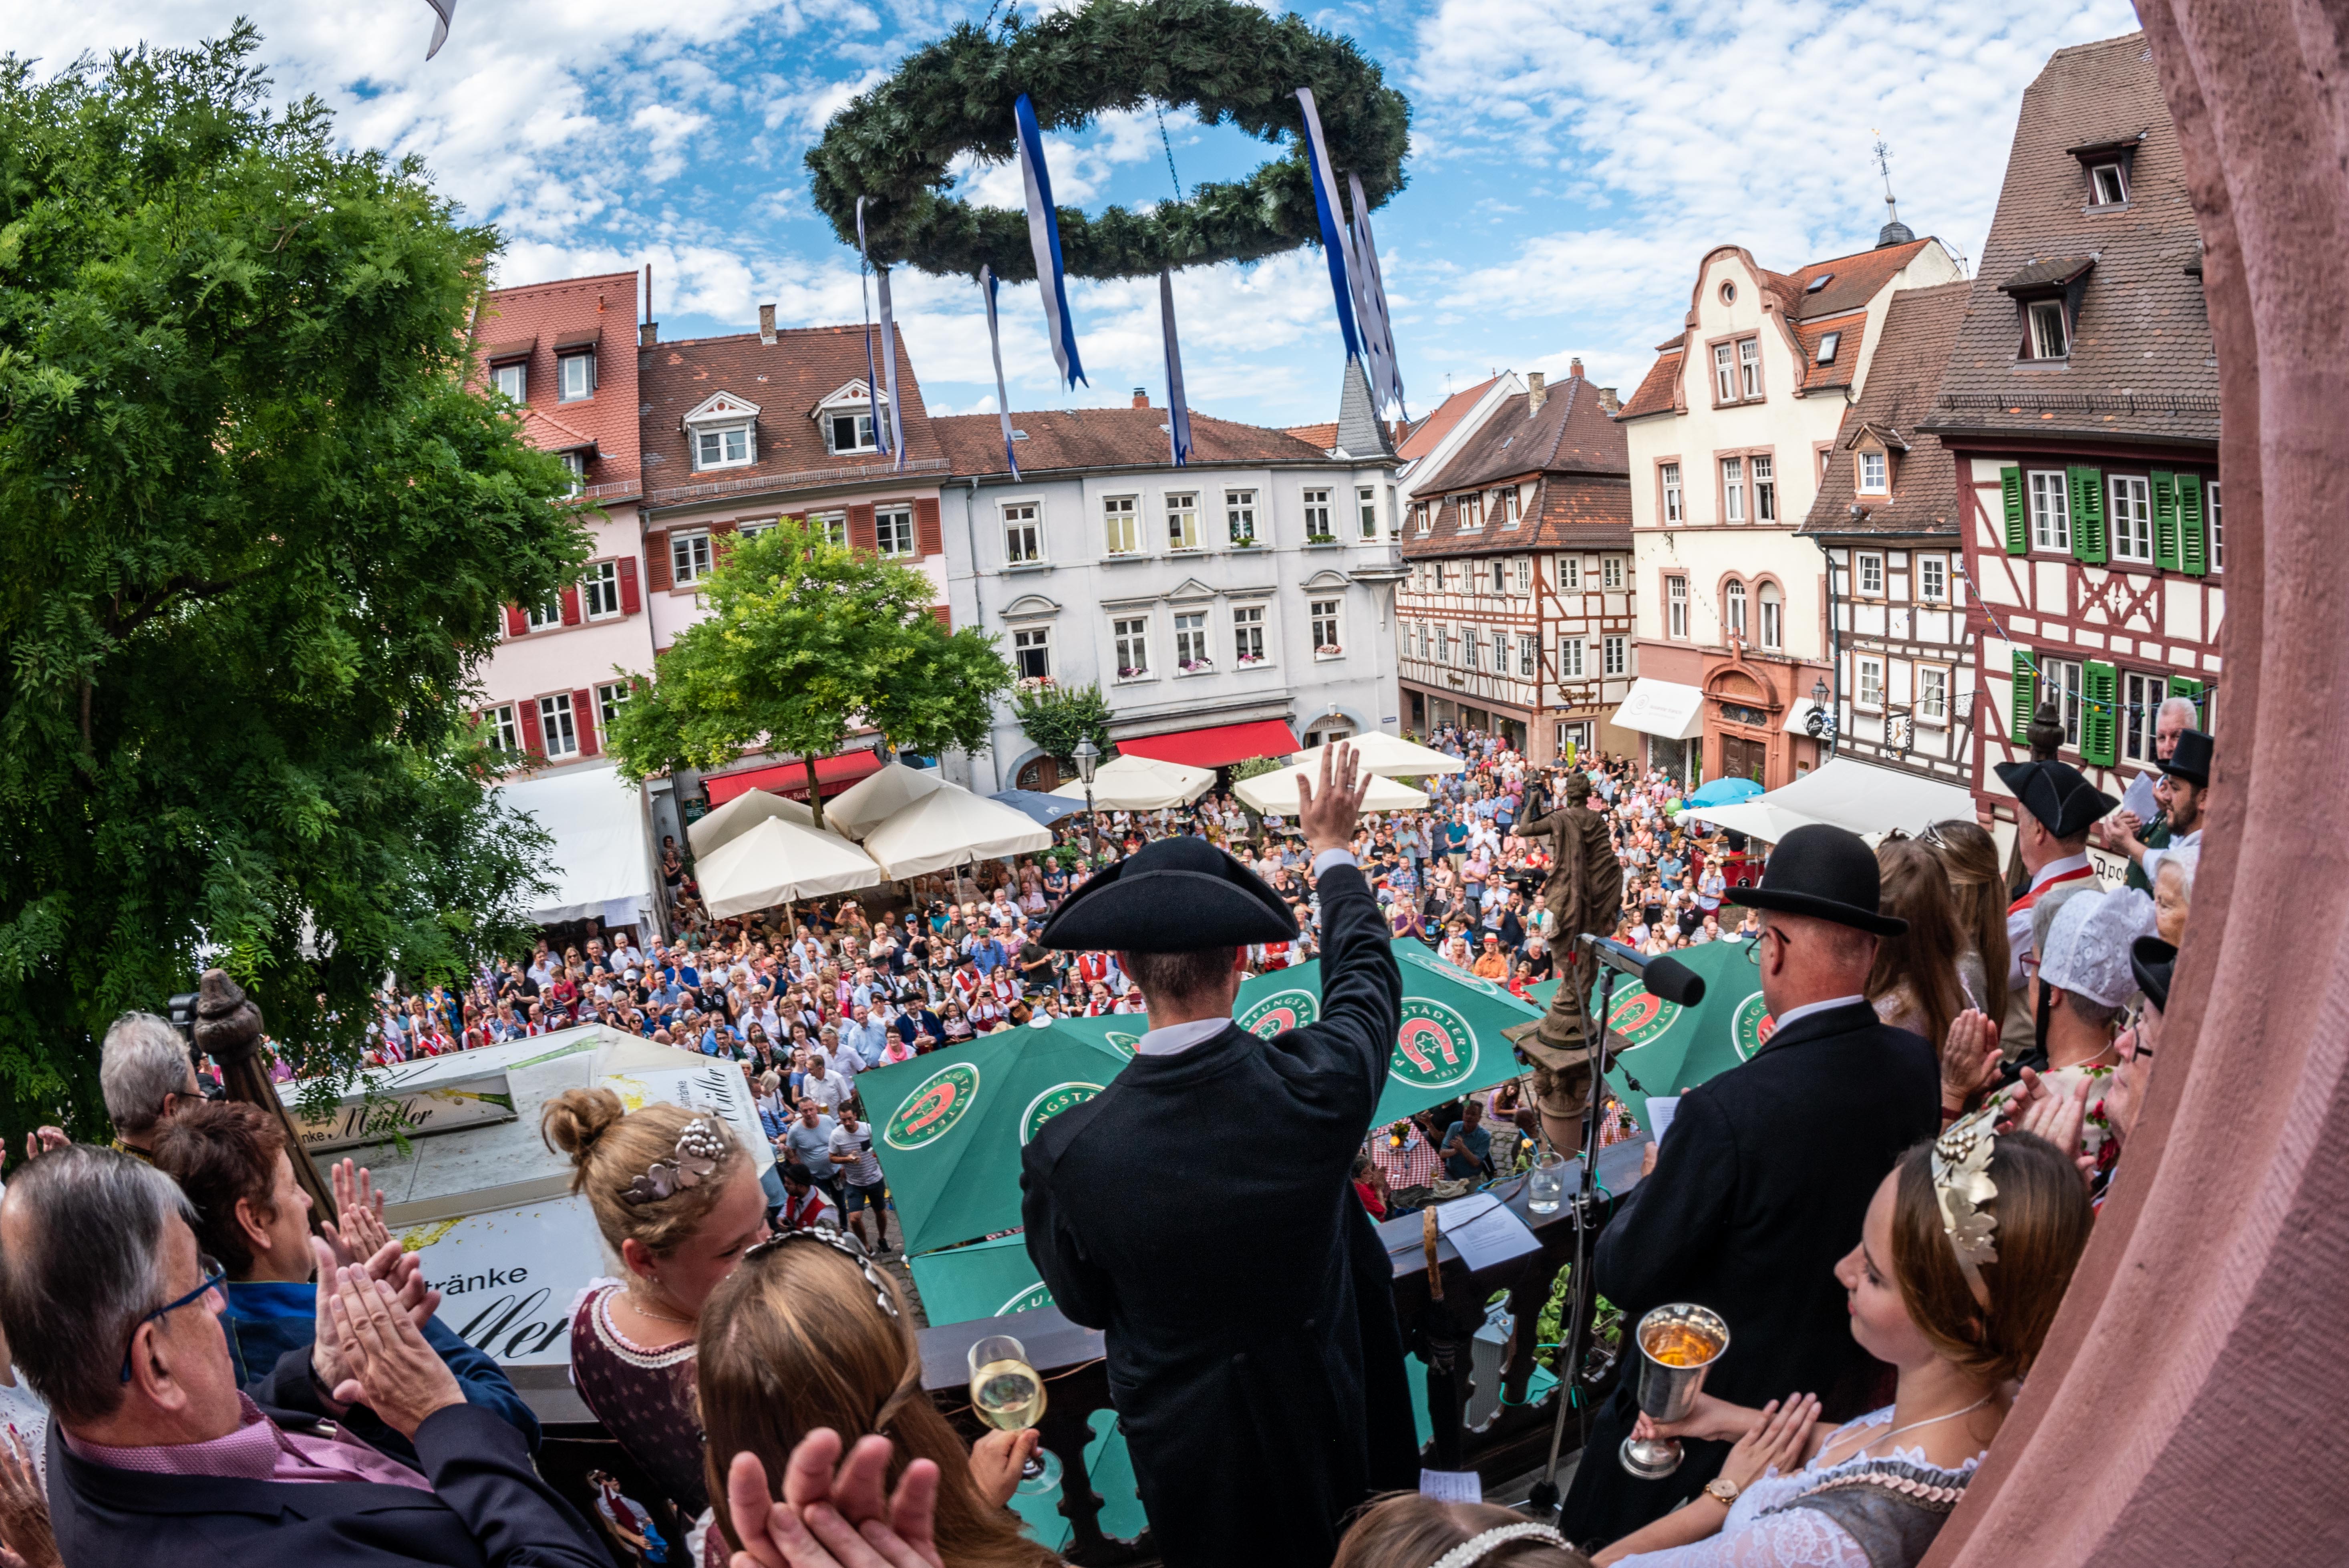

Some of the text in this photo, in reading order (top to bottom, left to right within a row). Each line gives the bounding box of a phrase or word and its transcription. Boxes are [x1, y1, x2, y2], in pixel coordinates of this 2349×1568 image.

[2093, 853, 2122, 881] Apo
[1243, 997, 1311, 1028] PFUNGSTÄD
[1435, 1068, 1458, 1079] 1831
[425, 1267, 527, 1295] tränke
